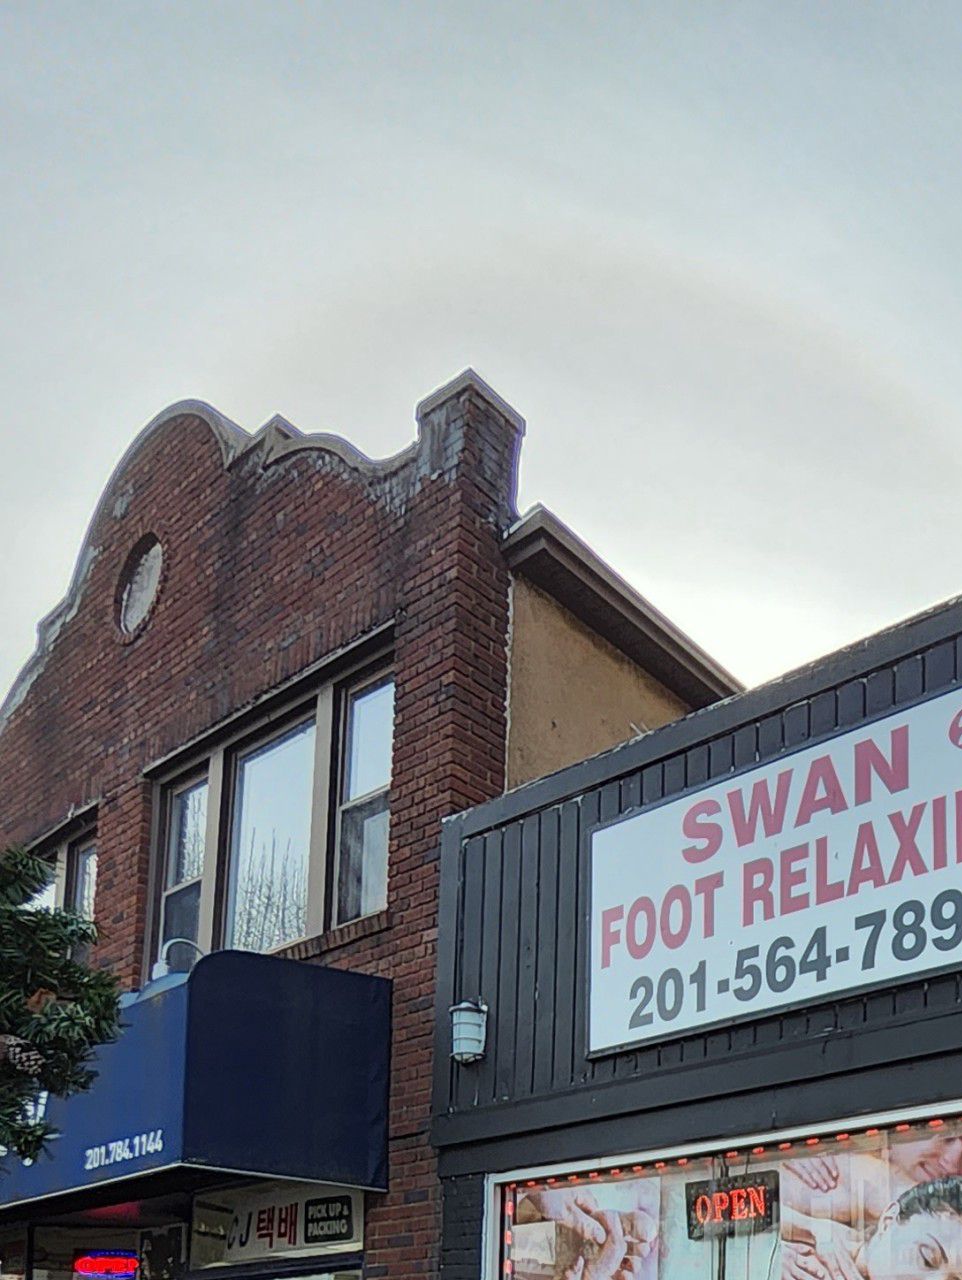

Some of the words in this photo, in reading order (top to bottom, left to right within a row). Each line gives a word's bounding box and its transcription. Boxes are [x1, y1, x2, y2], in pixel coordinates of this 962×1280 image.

[681, 724, 910, 864] SWAN
[600, 870, 725, 969] FOOT
[84, 1129, 164, 1171] 201.784.1144
[256, 1202, 299, 1249] 택배
[307, 1204, 328, 1220] PICK
[328, 1202, 342, 1218] UP
[695, 1185, 767, 1224] OPEN
[307, 1220, 348, 1237] PACKING
